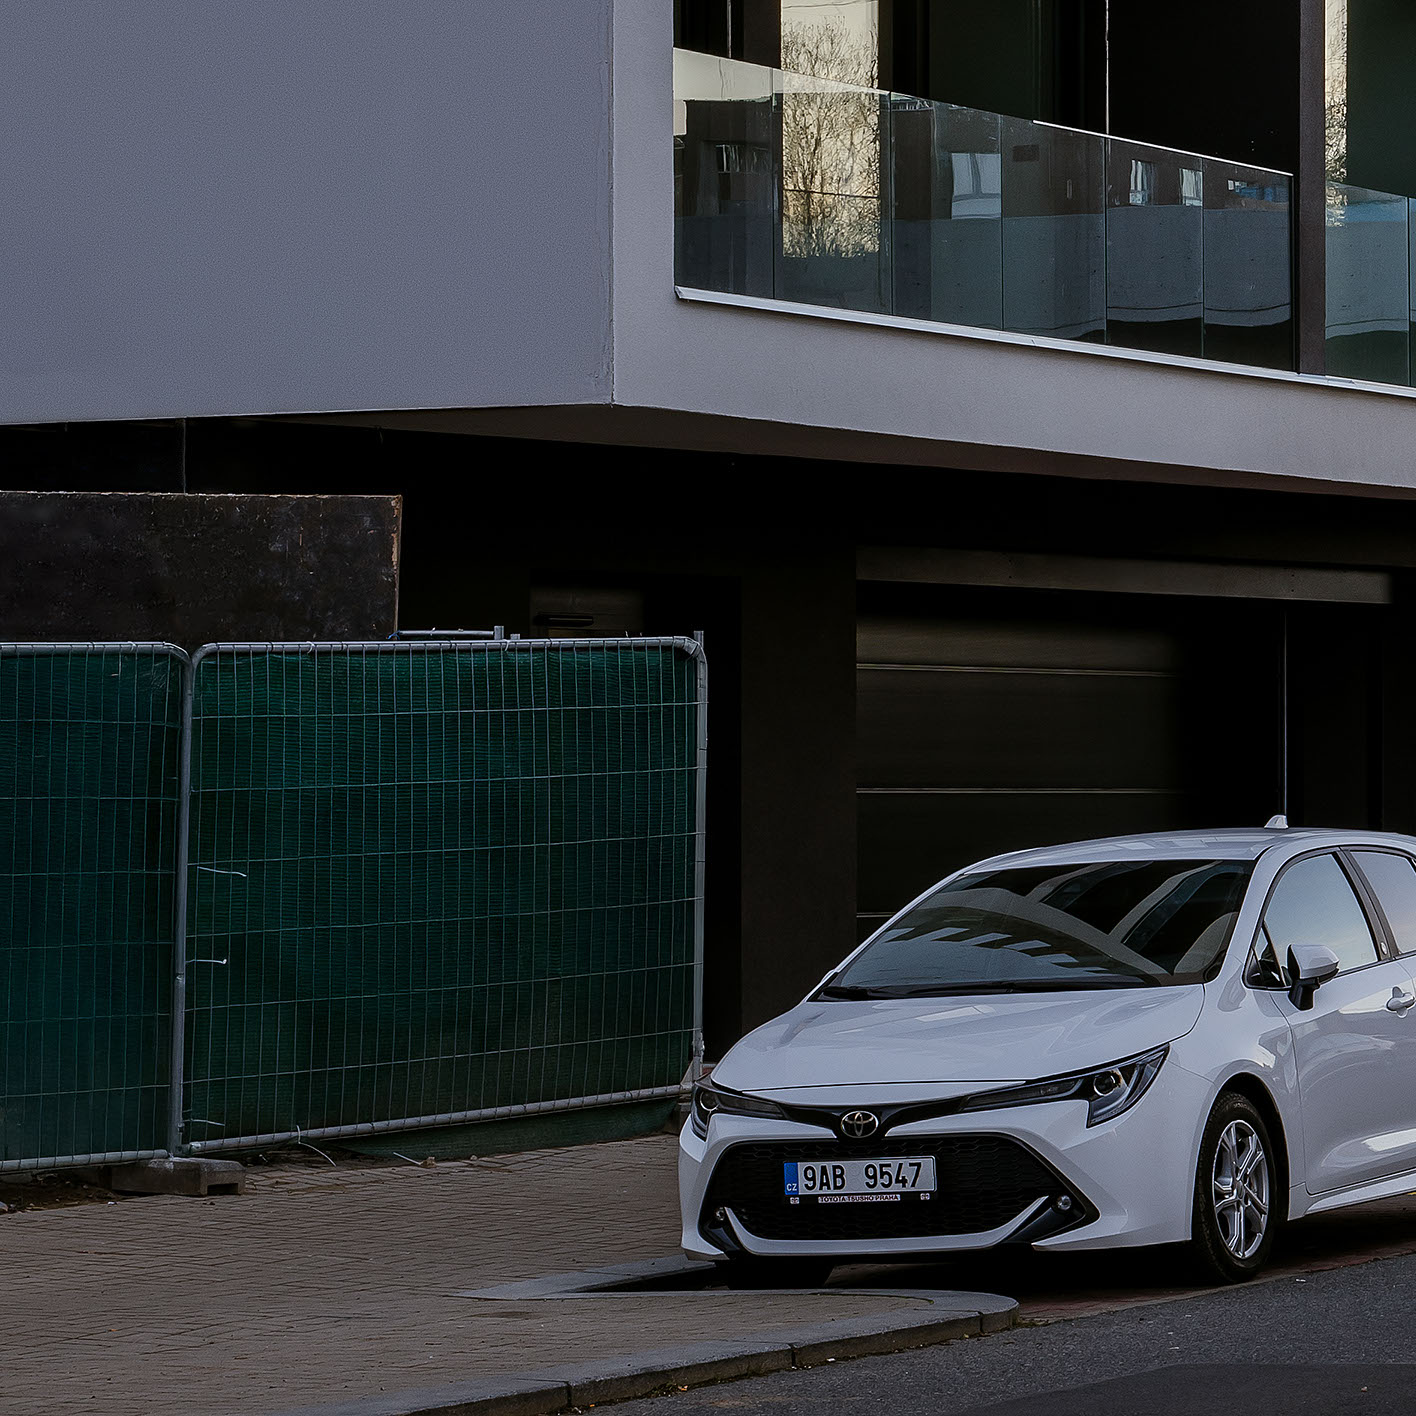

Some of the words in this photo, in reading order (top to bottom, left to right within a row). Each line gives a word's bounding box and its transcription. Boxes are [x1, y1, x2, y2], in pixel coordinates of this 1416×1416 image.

[803, 1164, 846, 1191] 9AB
[864, 1161, 922, 1189] 9547
[786, 1183, 798, 1192] CZ
[820, 1195, 846, 1203] TOYOTA
